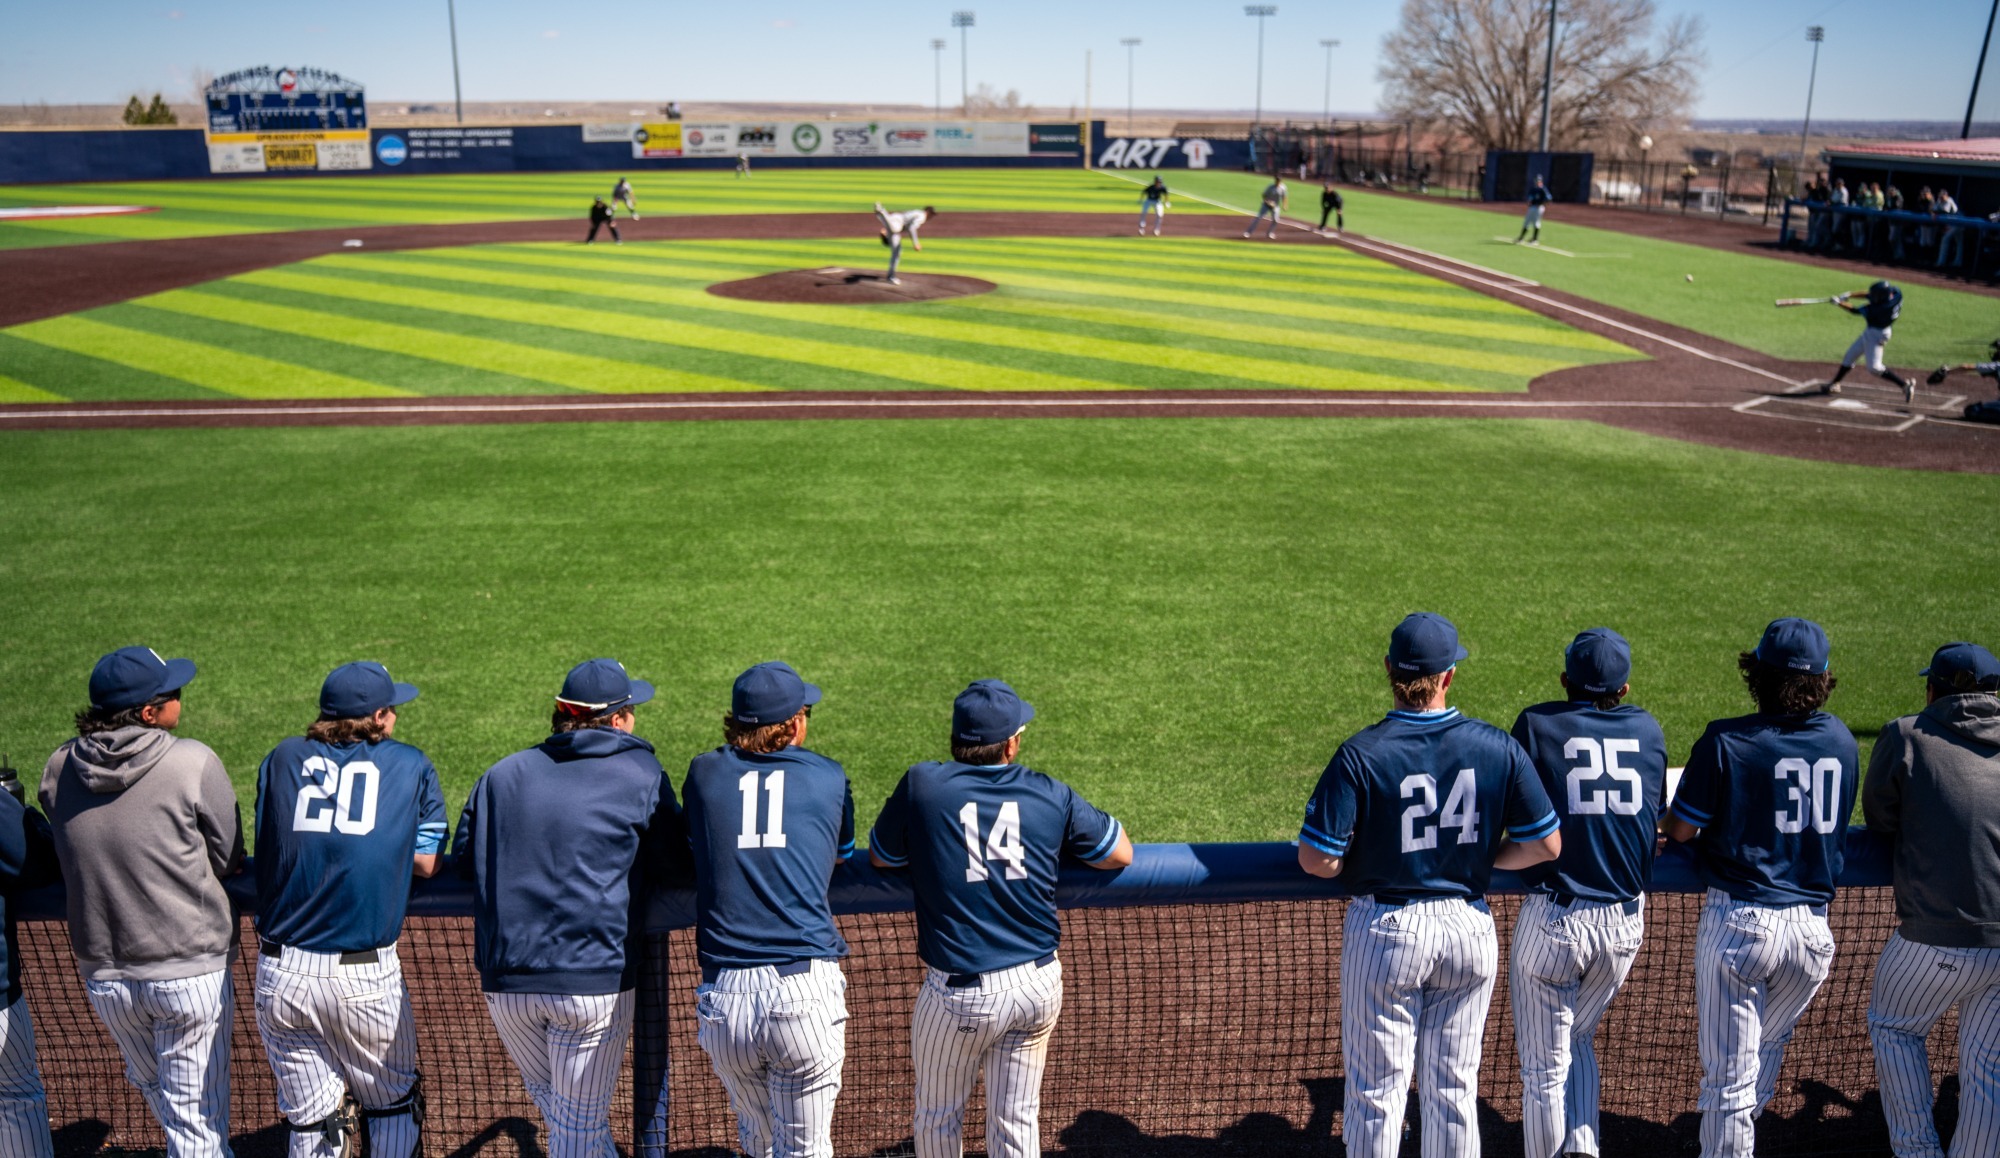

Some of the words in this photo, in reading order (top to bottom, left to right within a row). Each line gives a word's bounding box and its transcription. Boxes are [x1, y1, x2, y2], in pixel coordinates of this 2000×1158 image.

[1098, 138, 1180, 169] ART
[292, 756, 380, 835] 20
[738, 770, 786, 849] 11
[1400, 768, 1480, 853] 24
[1564, 737, 1642, 815] 25
[1774, 757, 1842, 834] 30
[959, 801, 1028, 882] 14
